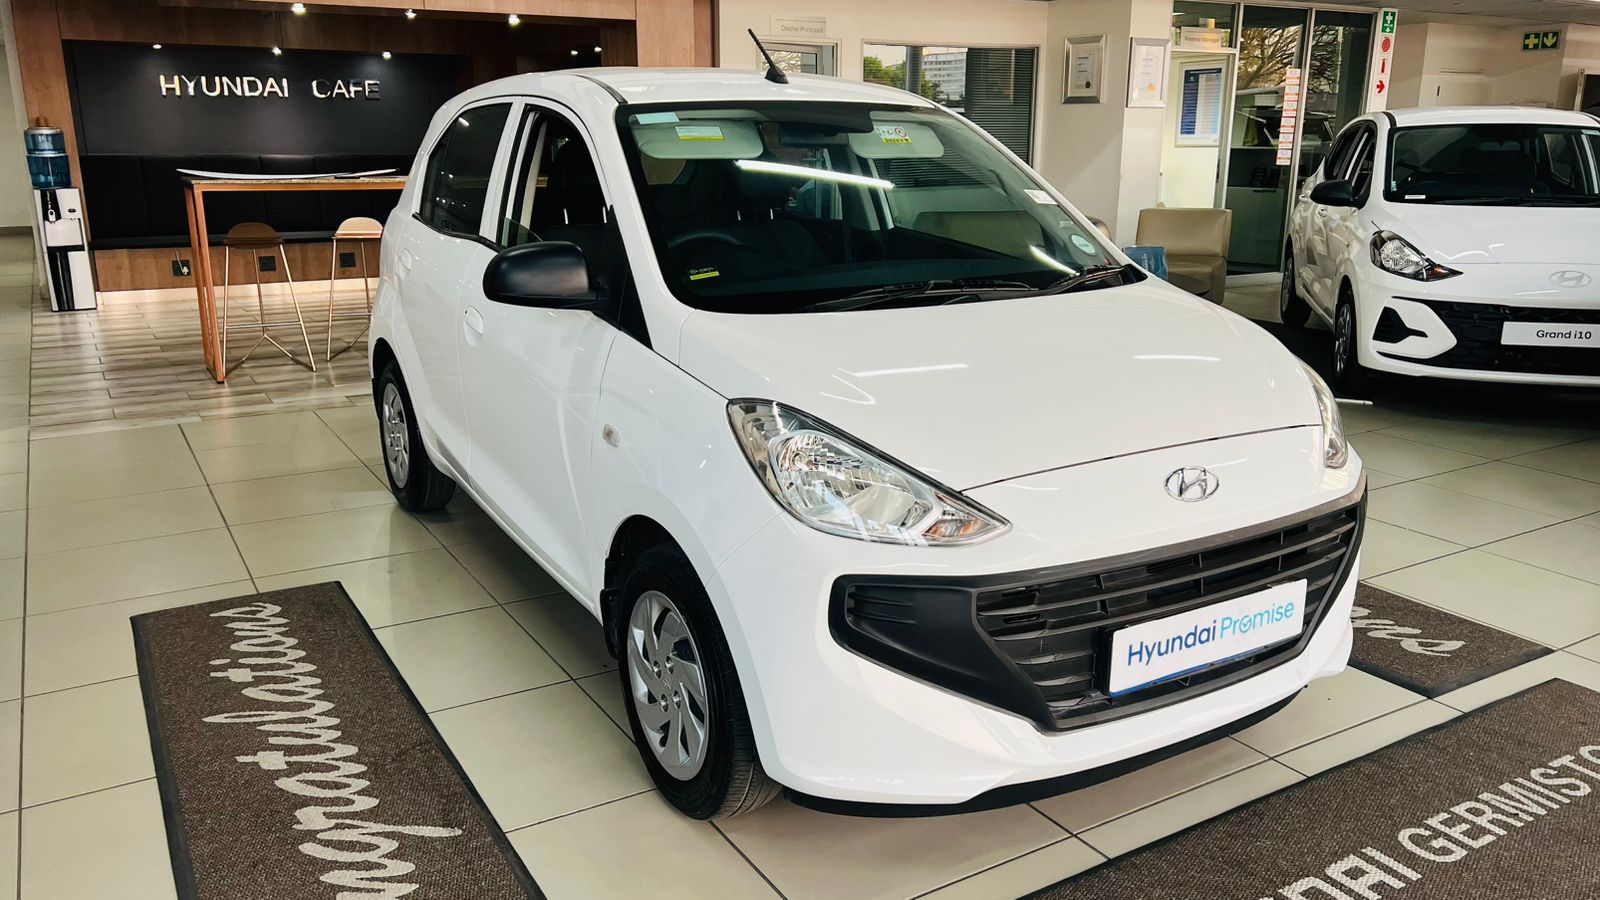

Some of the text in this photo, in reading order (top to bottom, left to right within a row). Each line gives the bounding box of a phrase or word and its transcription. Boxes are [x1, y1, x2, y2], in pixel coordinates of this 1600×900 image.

[159, 74, 381, 100] HYUNDAI CAFE
[1536, 329, 1592, 340] Grand i10
[1127, 602, 1295, 666] Hyundai Promise
